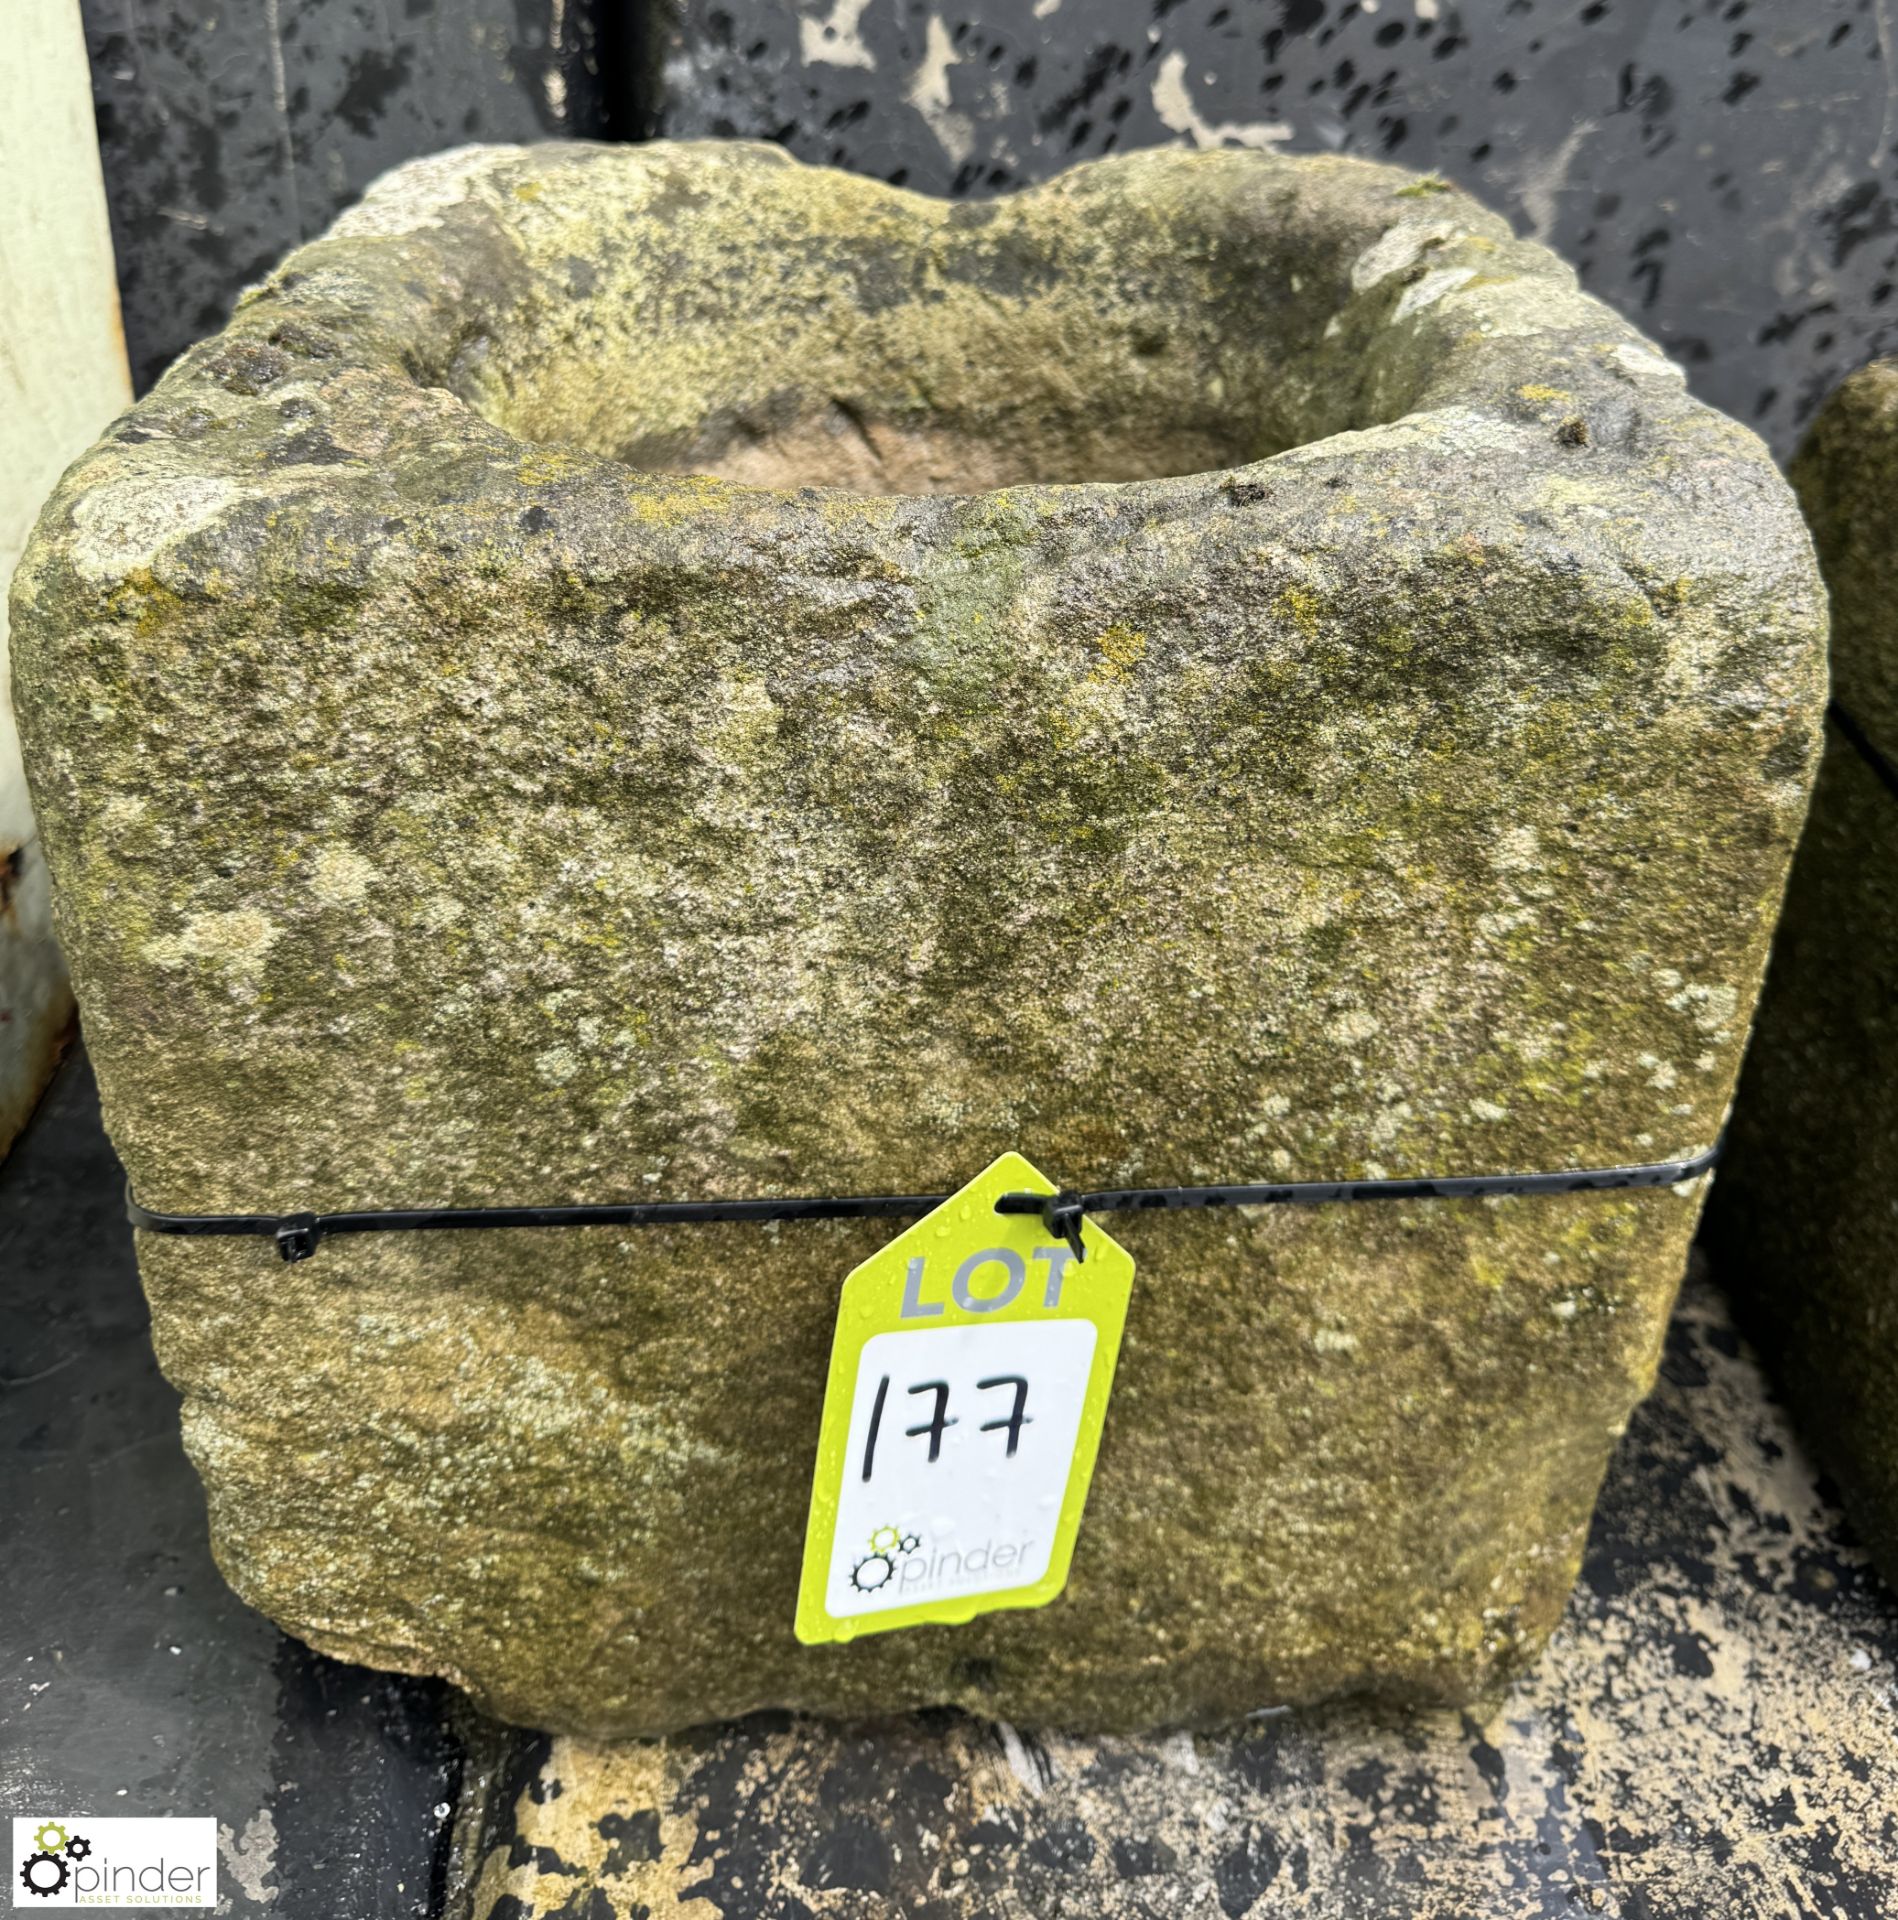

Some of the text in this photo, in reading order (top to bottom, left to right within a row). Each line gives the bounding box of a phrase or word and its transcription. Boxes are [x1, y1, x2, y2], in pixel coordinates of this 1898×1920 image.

[900, 1246, 1087, 1319] LOT
[862, 1374, 1033, 1483] 177
[899, 1538, 1035, 1595] pinder
